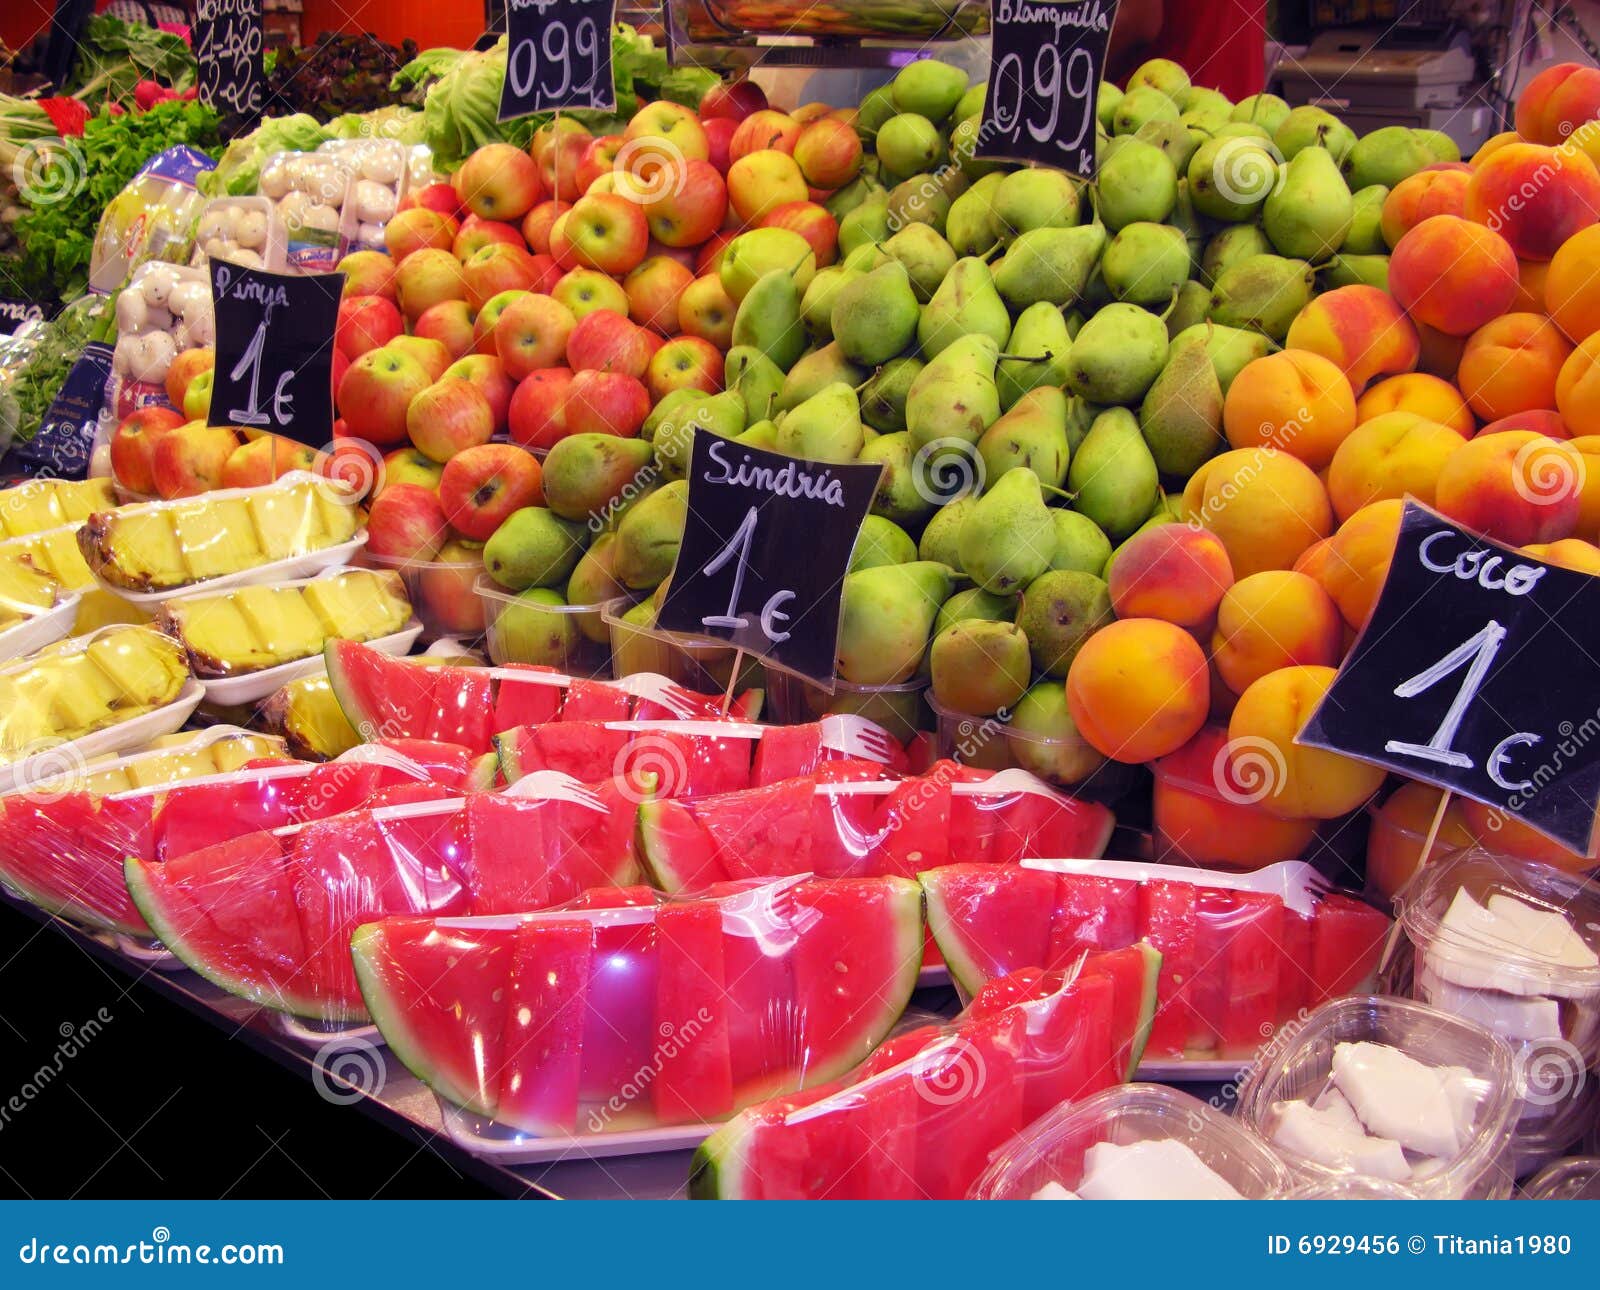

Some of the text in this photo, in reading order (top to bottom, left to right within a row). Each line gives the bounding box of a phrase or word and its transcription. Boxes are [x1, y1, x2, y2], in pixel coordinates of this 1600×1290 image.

[510, 17, 598, 111] 0,99
[996, 0, 1108, 44] Blanquilla
[993, 43, 1093, 151] 0,99
